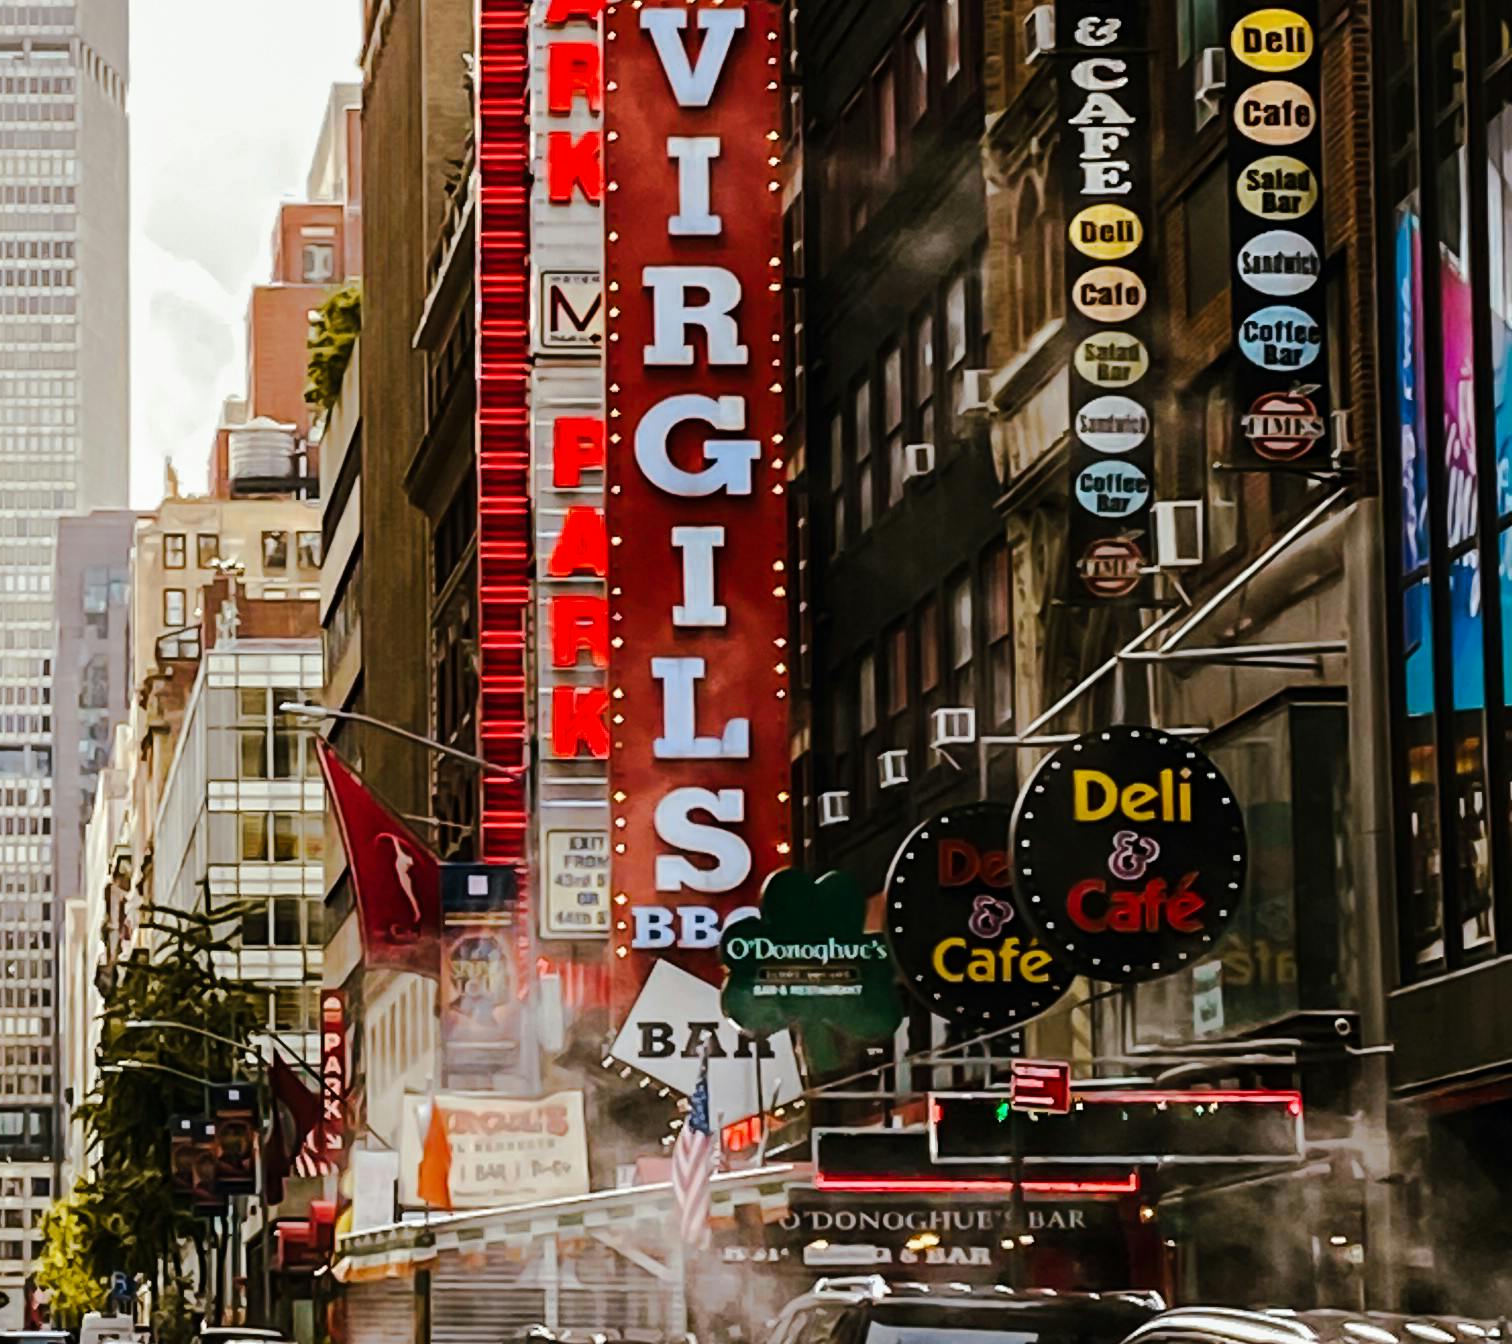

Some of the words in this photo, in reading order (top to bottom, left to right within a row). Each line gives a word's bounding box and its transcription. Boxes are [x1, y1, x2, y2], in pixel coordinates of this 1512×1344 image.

[1074, 16, 1122, 46] &
[1242, 27, 1306, 54] Deli
[1068, 59, 1136, 195] CAFE
[1242, 100, 1310, 127] Cafe
[1247, 169, 1310, 192] Salad
[1261, 192, 1302, 214] Bar
[1080, 221, 1134, 244] Deli
[1243, 320, 1321, 344] Coffee
[1262, 342, 1302, 365] Bar
[634, 7, 762, 893] VIRGILS
[1080, 473, 1148, 494] Coffee
[548, 416, 610, 759] PARK
[1073, 767, 1192, 822] Deli
[939, 838, 1013, 888] De
[1108, 830, 1161, 881] &
[969, 895, 1015, 939] &
[1066, 872, 1207, 934] Café
[727, 937, 888, 966] O'Donoghue's
[932, 936, 1054, 983] Café
[637, 1021, 775, 1058] BAR
[324, 1032, 342, 1120] PARK
[1029, 1211, 1086, 1230] BAR
